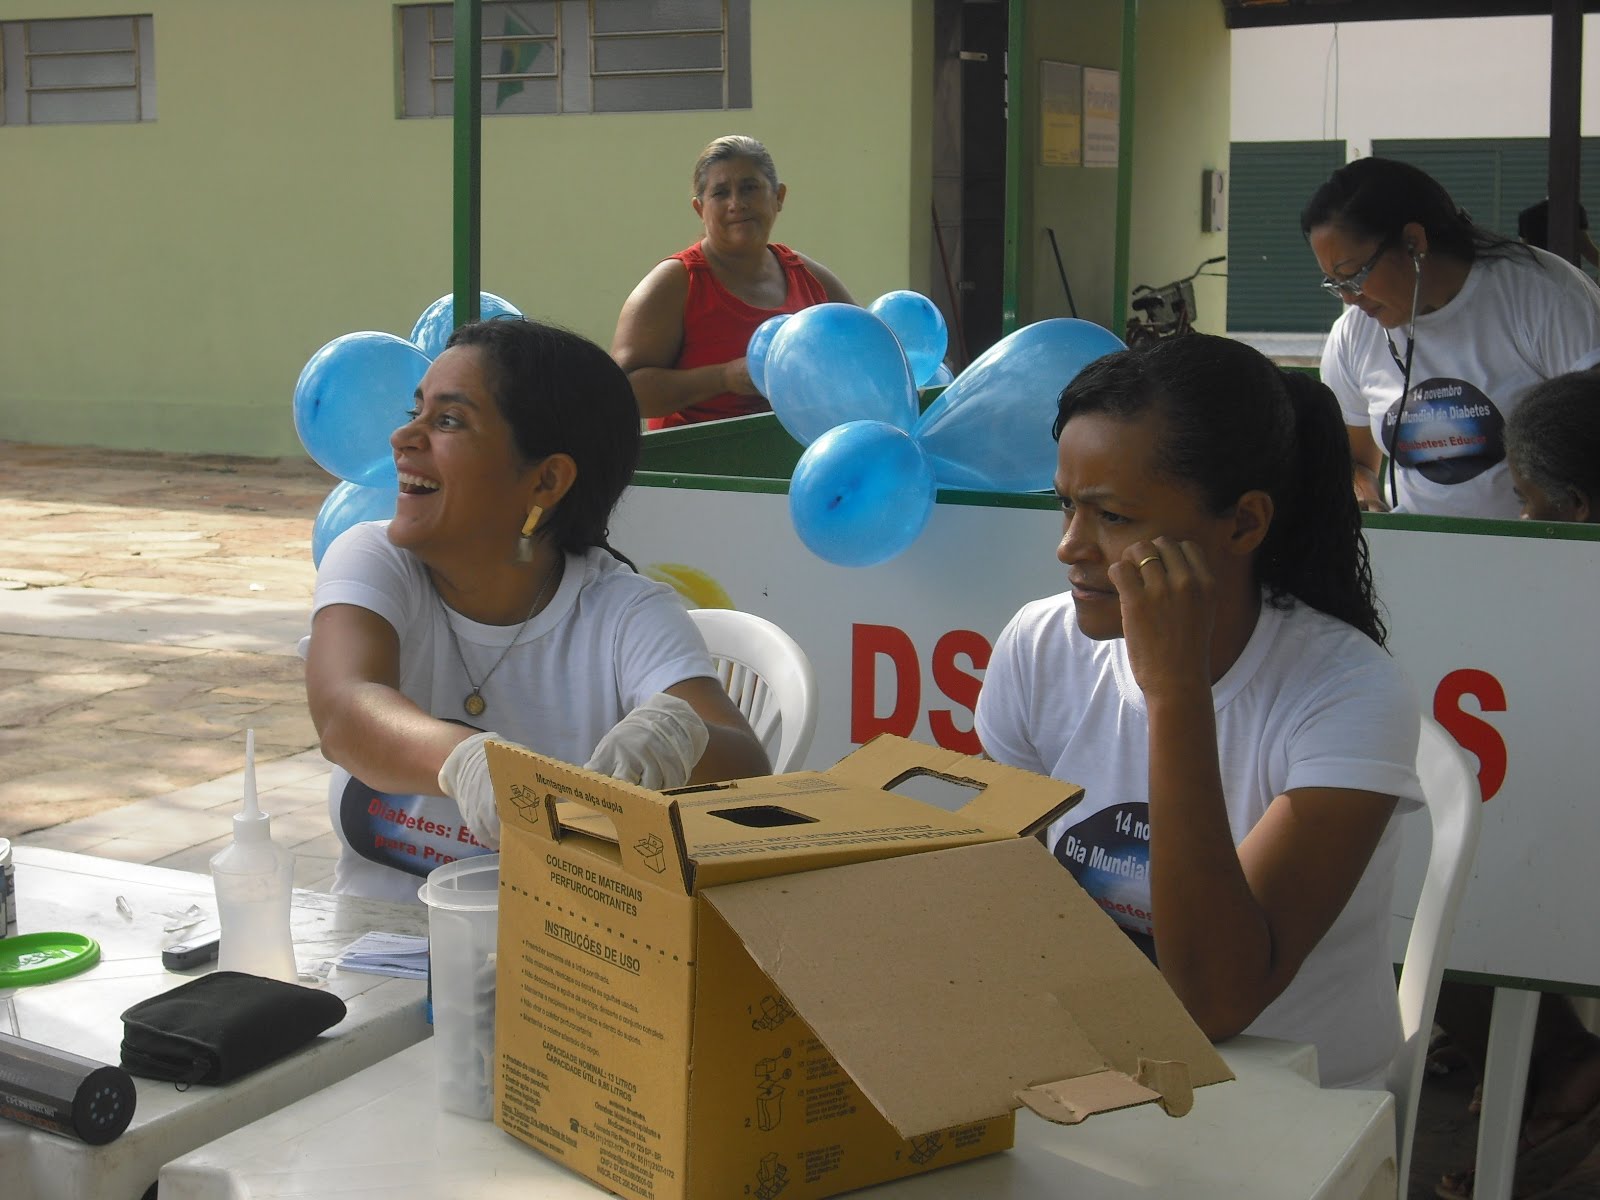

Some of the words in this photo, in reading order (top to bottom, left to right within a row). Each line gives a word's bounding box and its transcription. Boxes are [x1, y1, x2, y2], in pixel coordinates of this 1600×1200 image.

[1413, 387, 1423, 400] 14
[1423, 384, 1462, 400] novembro
[1449, 403, 1491, 420] Diabetes
[535, 772, 573, 797] Montagem
[575, 786, 584, 798] da
[584, 790, 601, 807] alça
[601, 796, 624, 814] dupla
[367, 797, 451, 838] Diabetes:
[1115, 810, 1133, 836] 14
[375, 834, 417, 856] para
[1065, 835, 1087, 864] Dia
[1089, 845, 1150, 881] Mundial
[546, 853, 584, 879] COLETOR
[585, 868, 597, 882] DE
[598, 872, 643, 902] MATERIAIS
[550, 872, 638, 917] PERFUROCORTANTES
[545, 919, 602, 955] INSTRUÇÕES
[604, 945, 618, 963] DE
[619, 951, 641, 972] USO
[542, 1040, 578, 1064] CAPACIDADE
[578, 1055, 607, 1079] NOMINAL:
[608, 1072, 615, 1083] 13
[615, 1075, 637, 1094] LITROS
[546, 1053, 582, 1077] CAPACIDADE
[582, 1070, 597, 1085] ÚTIL:
[610, 1085, 632, 1102] LITROS
[744, 1117, 751, 1128] 2
